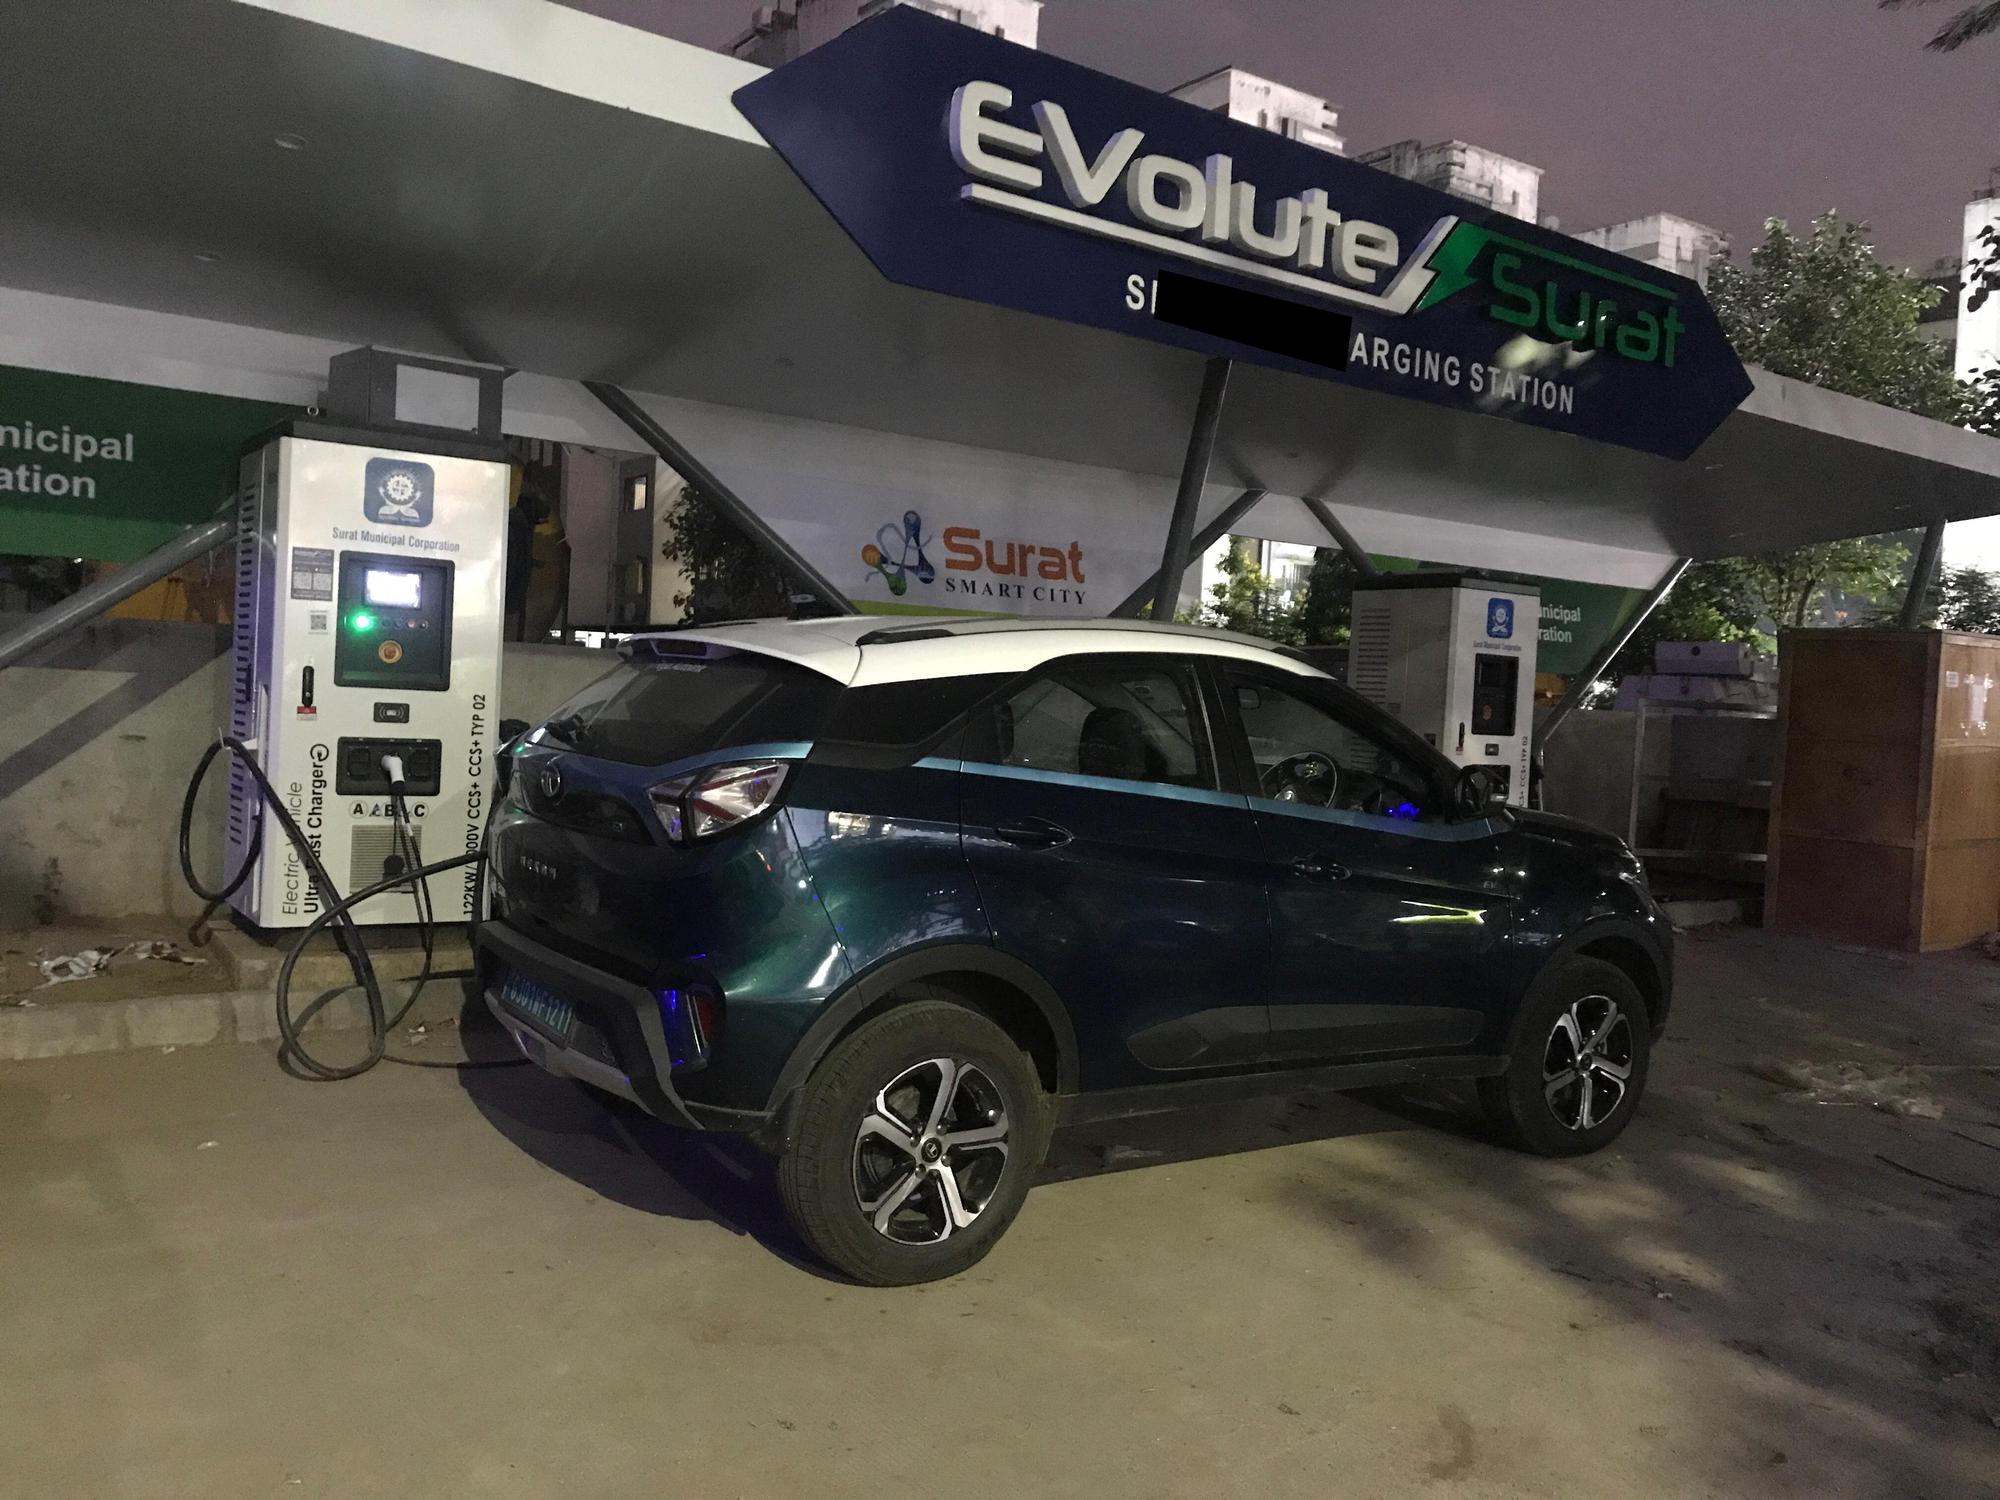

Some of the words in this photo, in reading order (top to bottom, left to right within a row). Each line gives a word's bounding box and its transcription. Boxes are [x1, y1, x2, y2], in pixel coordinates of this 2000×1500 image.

[949, 79, 1399, 284] EVolute
[1490, 252, 1686, 368] Surat
[1349, 333, 1461, 387] ARGING
[1470, 362, 1575, 415] STATION
[332, 527, 358, 541] Surat
[361, 530, 406, 547] Municipal
[408, 536, 460, 552] Corporation
[943, 526, 1086, 584] Surat
[945, 577, 1025, 599] SMART
[1033, 587, 1086, 605] CITY
[473, 693, 487, 710] 02
[471, 713, 486, 737] TYP
[468, 739, 483, 777] CCS+
[307, 762, 327, 829] Charger
[414, 804, 425, 817] C
[467, 782, 482, 820] CCS+
[282, 852, 300, 915] Electric
